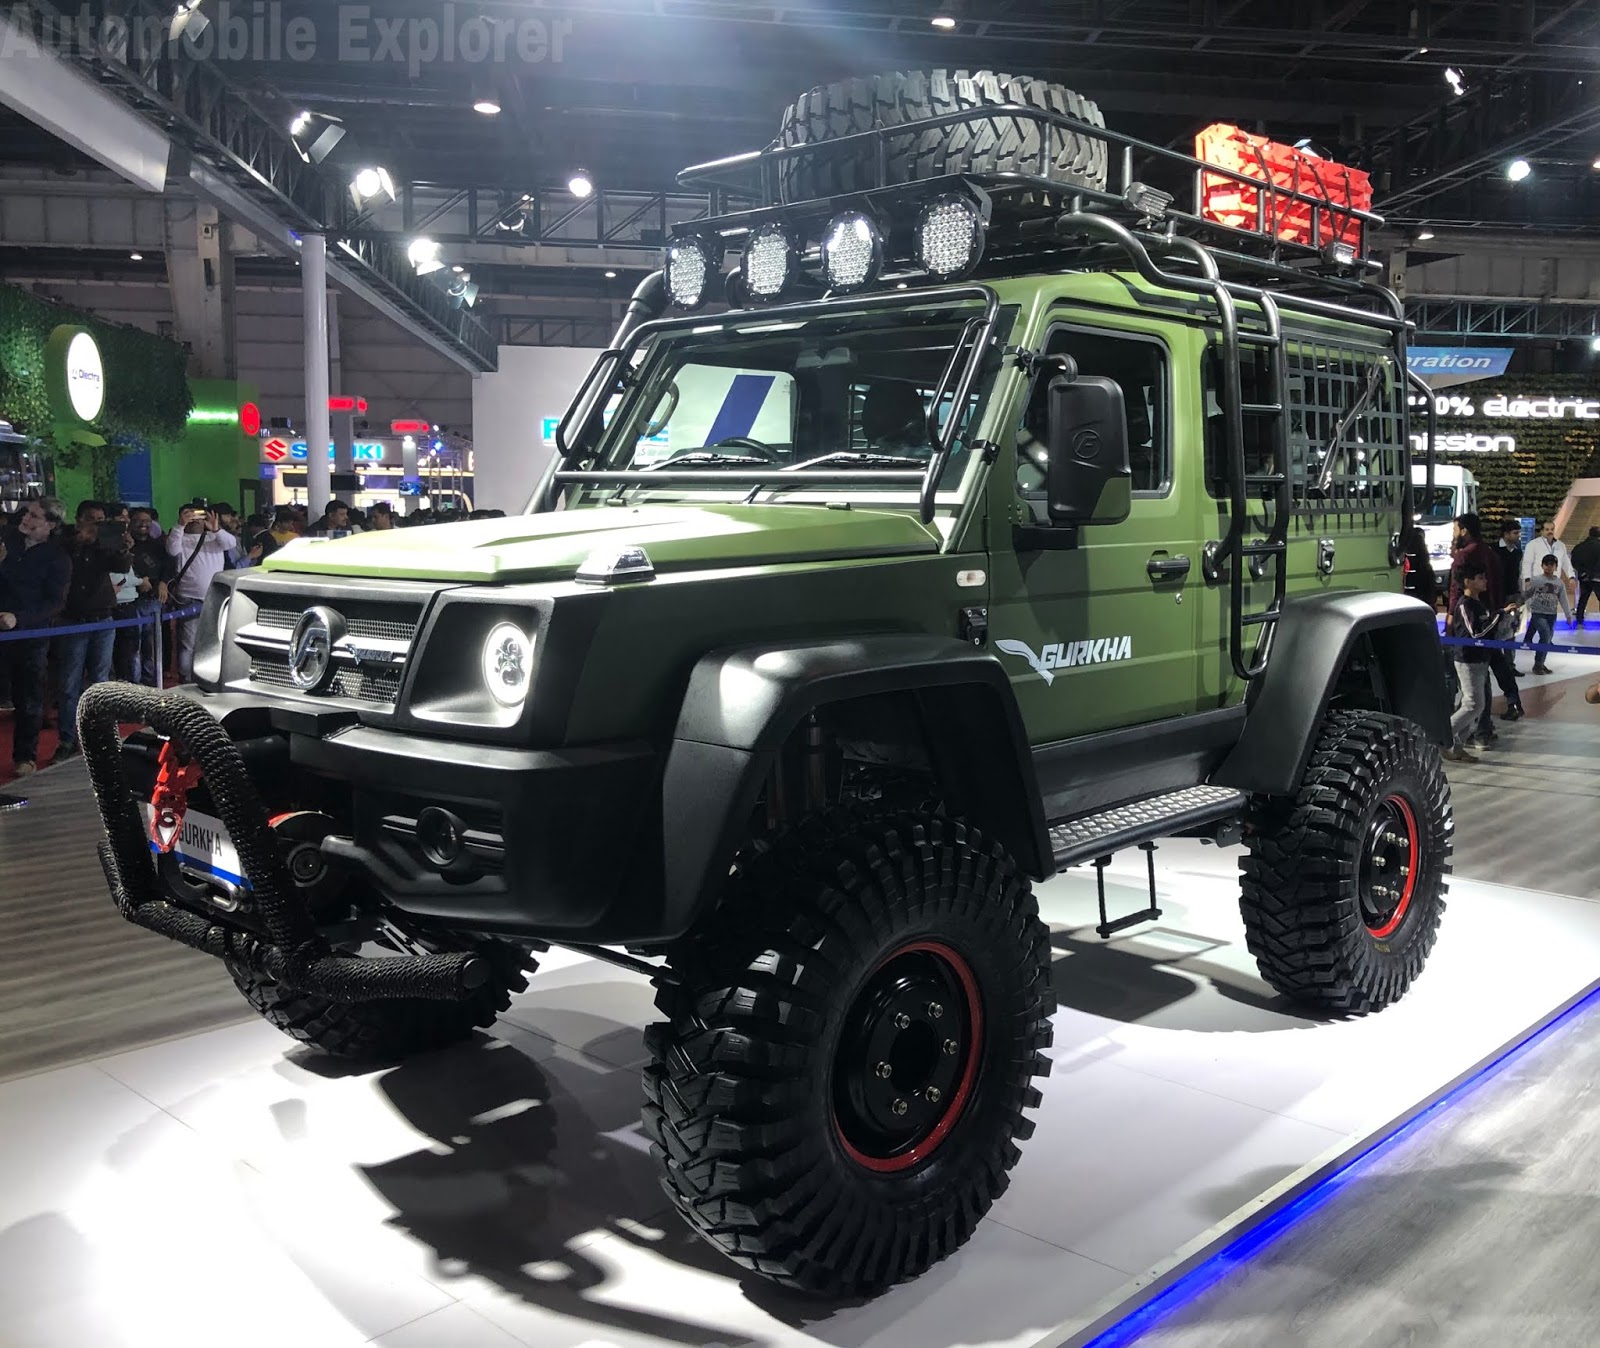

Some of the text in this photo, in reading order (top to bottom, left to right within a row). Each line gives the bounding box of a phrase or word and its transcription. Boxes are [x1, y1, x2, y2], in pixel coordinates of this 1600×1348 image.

[1483, 397, 1600, 418] electric
[291, 443, 382, 459] SKI
[1039, 635, 1132, 670] GURKHA
